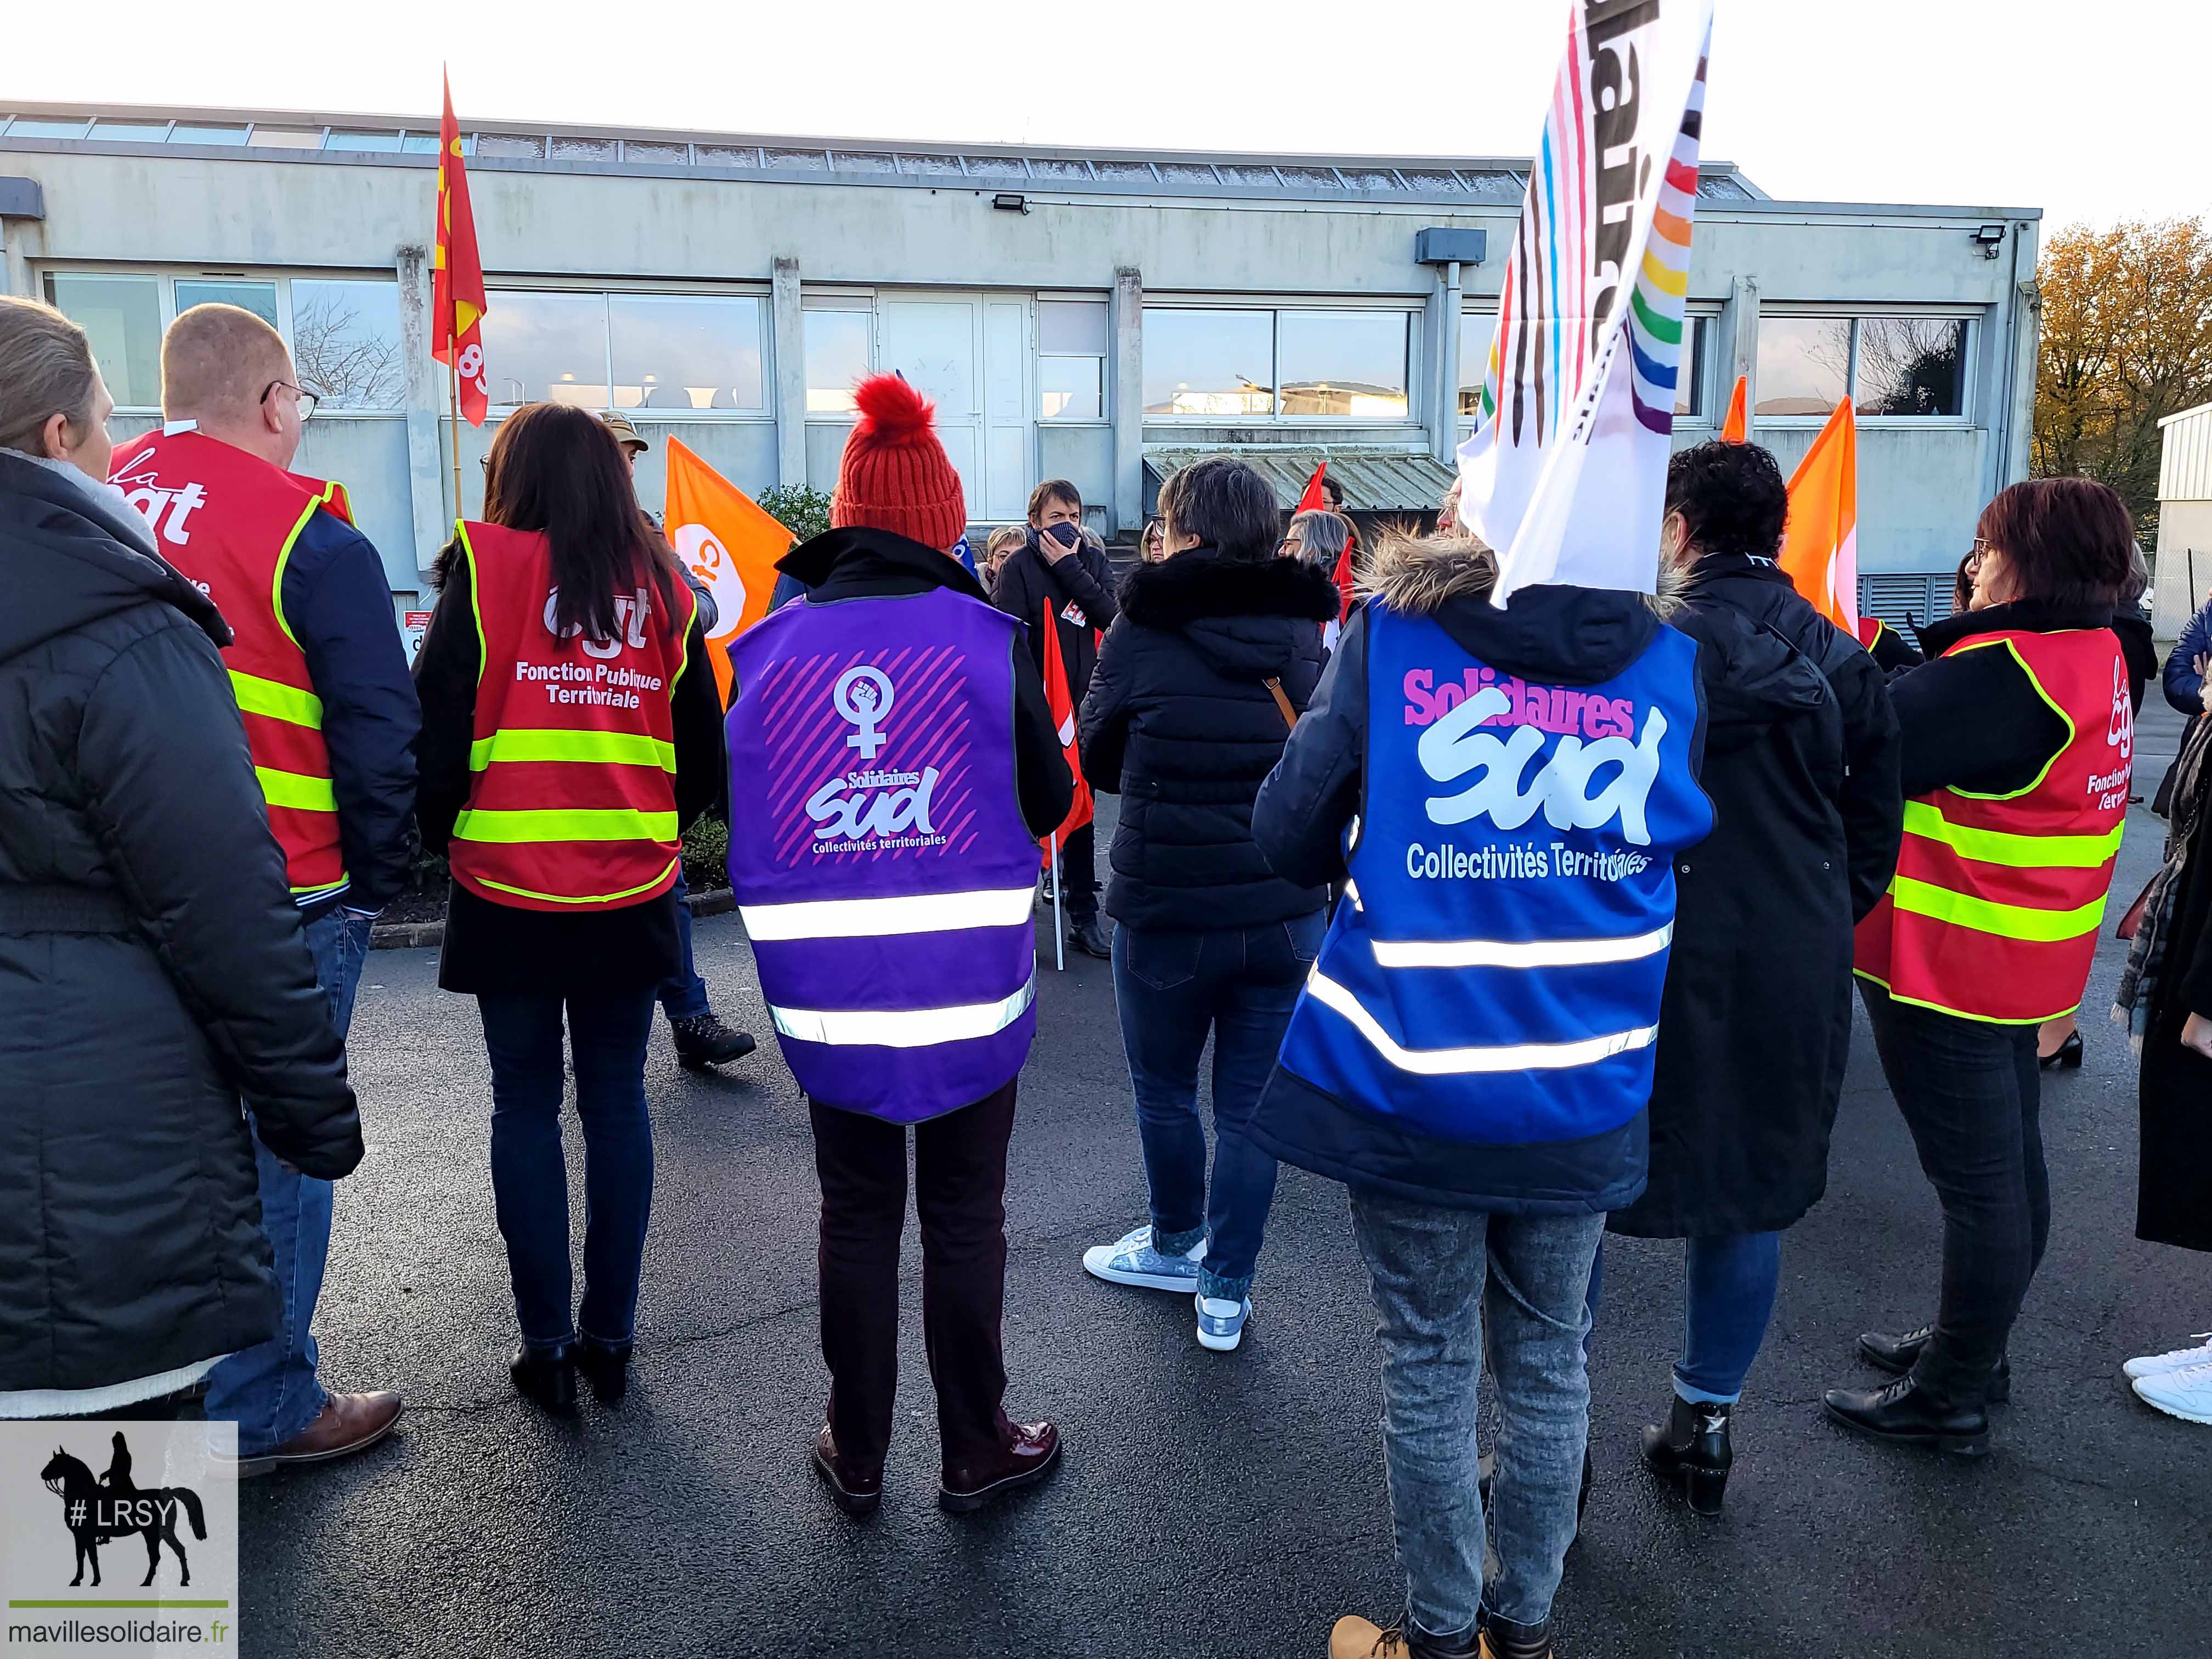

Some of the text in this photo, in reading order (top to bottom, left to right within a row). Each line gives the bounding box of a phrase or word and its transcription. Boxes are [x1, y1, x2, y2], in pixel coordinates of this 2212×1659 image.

[106, 447, 207, 495] la
[516, 662, 593, 681] Fonction
[2113, 655, 2129, 705] la
[1403, 667, 1634, 740] Solidaires
[2107, 695, 2134, 759] cg
[848, 768, 920, 789] Solidaires
[812, 834, 947, 854] Collectivités territoriales
[1407, 842, 1549, 879] Collectivités
